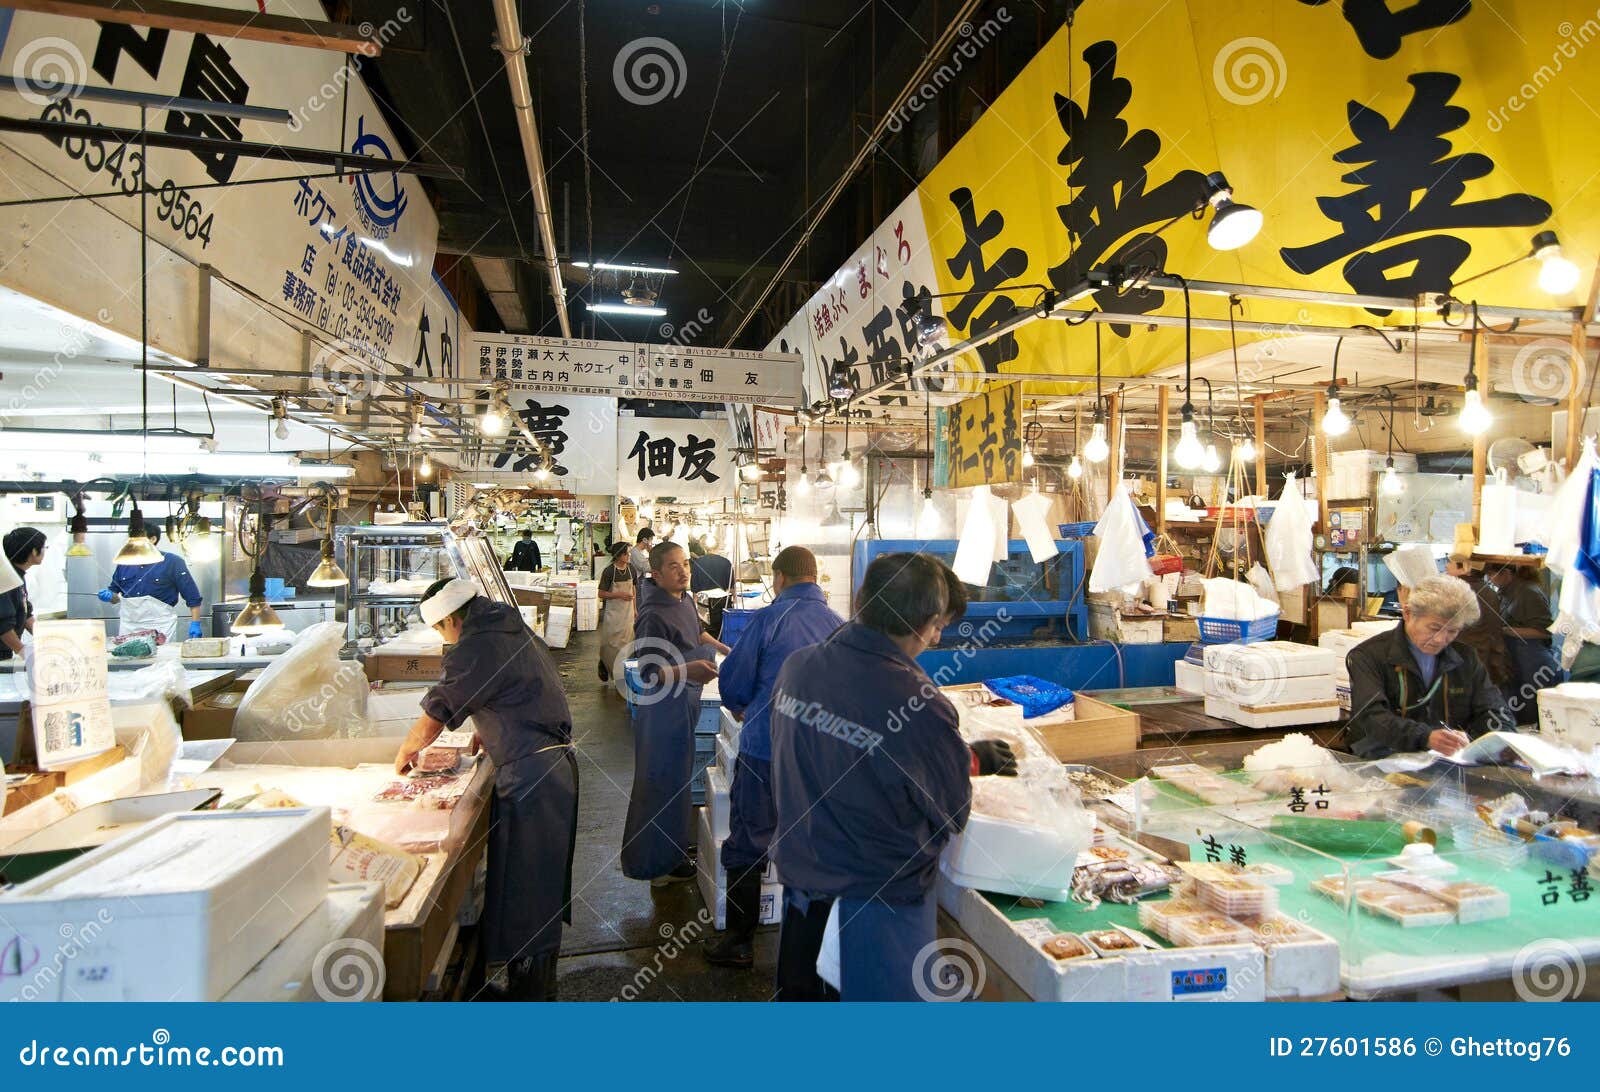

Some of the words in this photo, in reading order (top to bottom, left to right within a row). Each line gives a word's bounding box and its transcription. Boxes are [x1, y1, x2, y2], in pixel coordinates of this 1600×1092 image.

[301, 244, 318, 277] 店
[282, 269, 318, 319] 事務所
[573, 362, 614, 375] ホクエイ
[627, 430, 720, 483] 佃友
[1537, 867, 1595, 906] 吉善
